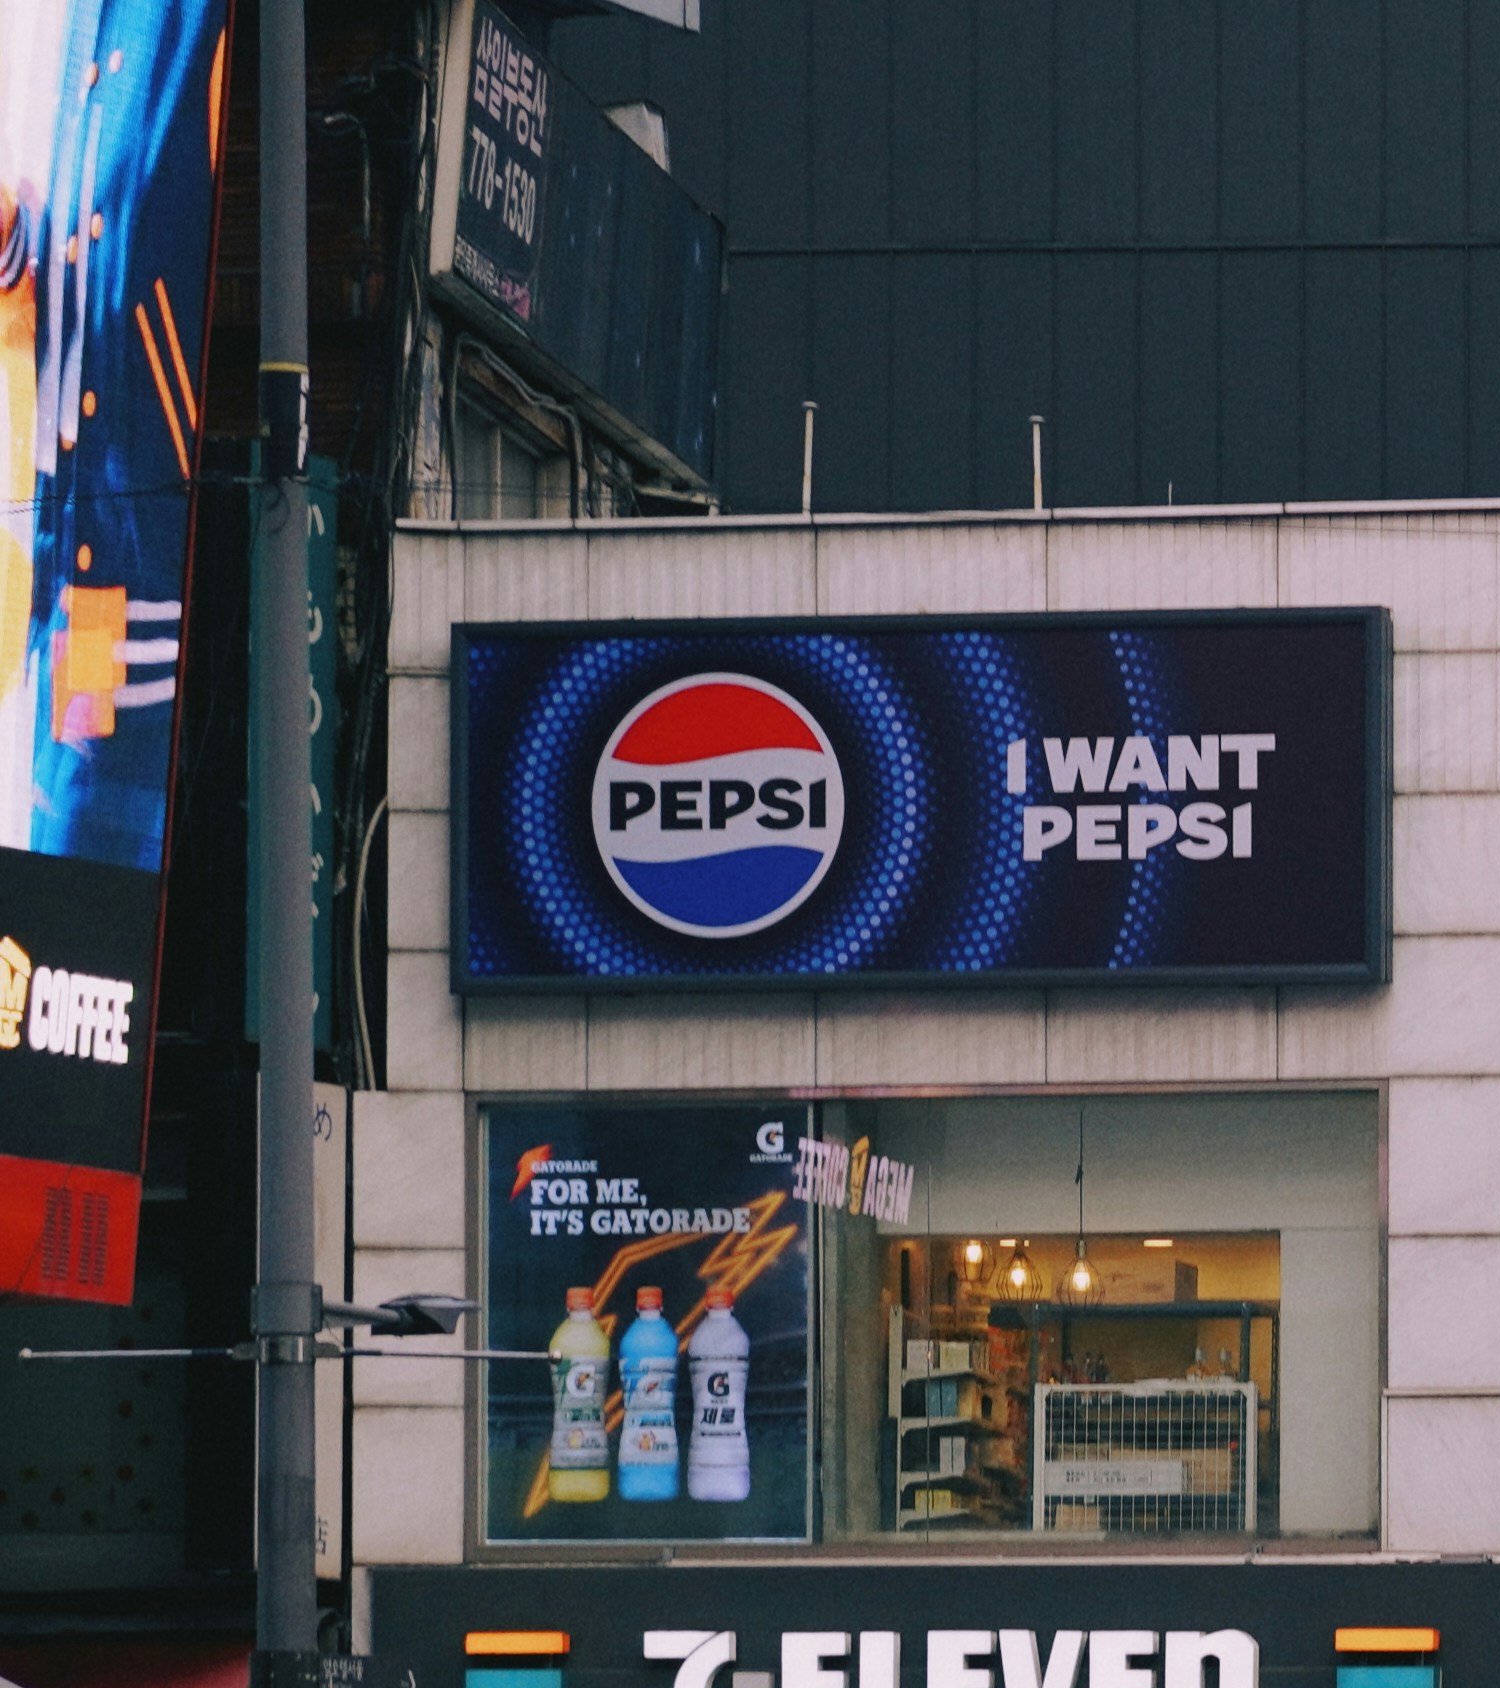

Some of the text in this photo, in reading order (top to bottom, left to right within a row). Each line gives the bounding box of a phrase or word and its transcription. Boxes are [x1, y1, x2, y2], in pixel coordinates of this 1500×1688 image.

[469, 125, 537, 245] 778-1530
[1006, 732, 1276, 795] I WANT
[610, 777, 827, 832] PEPSI
[1022, 801, 1253, 863] PEPSI
[28, 965, 134, 1065] COFFEE
[531, 1160, 598, 1173] GATORADE
[749, 1153, 793, 1163] GATORADE
[530, 1178, 647, 1207] FOR ME,
[530, 1208, 751, 1235] IT'S GATORADE
